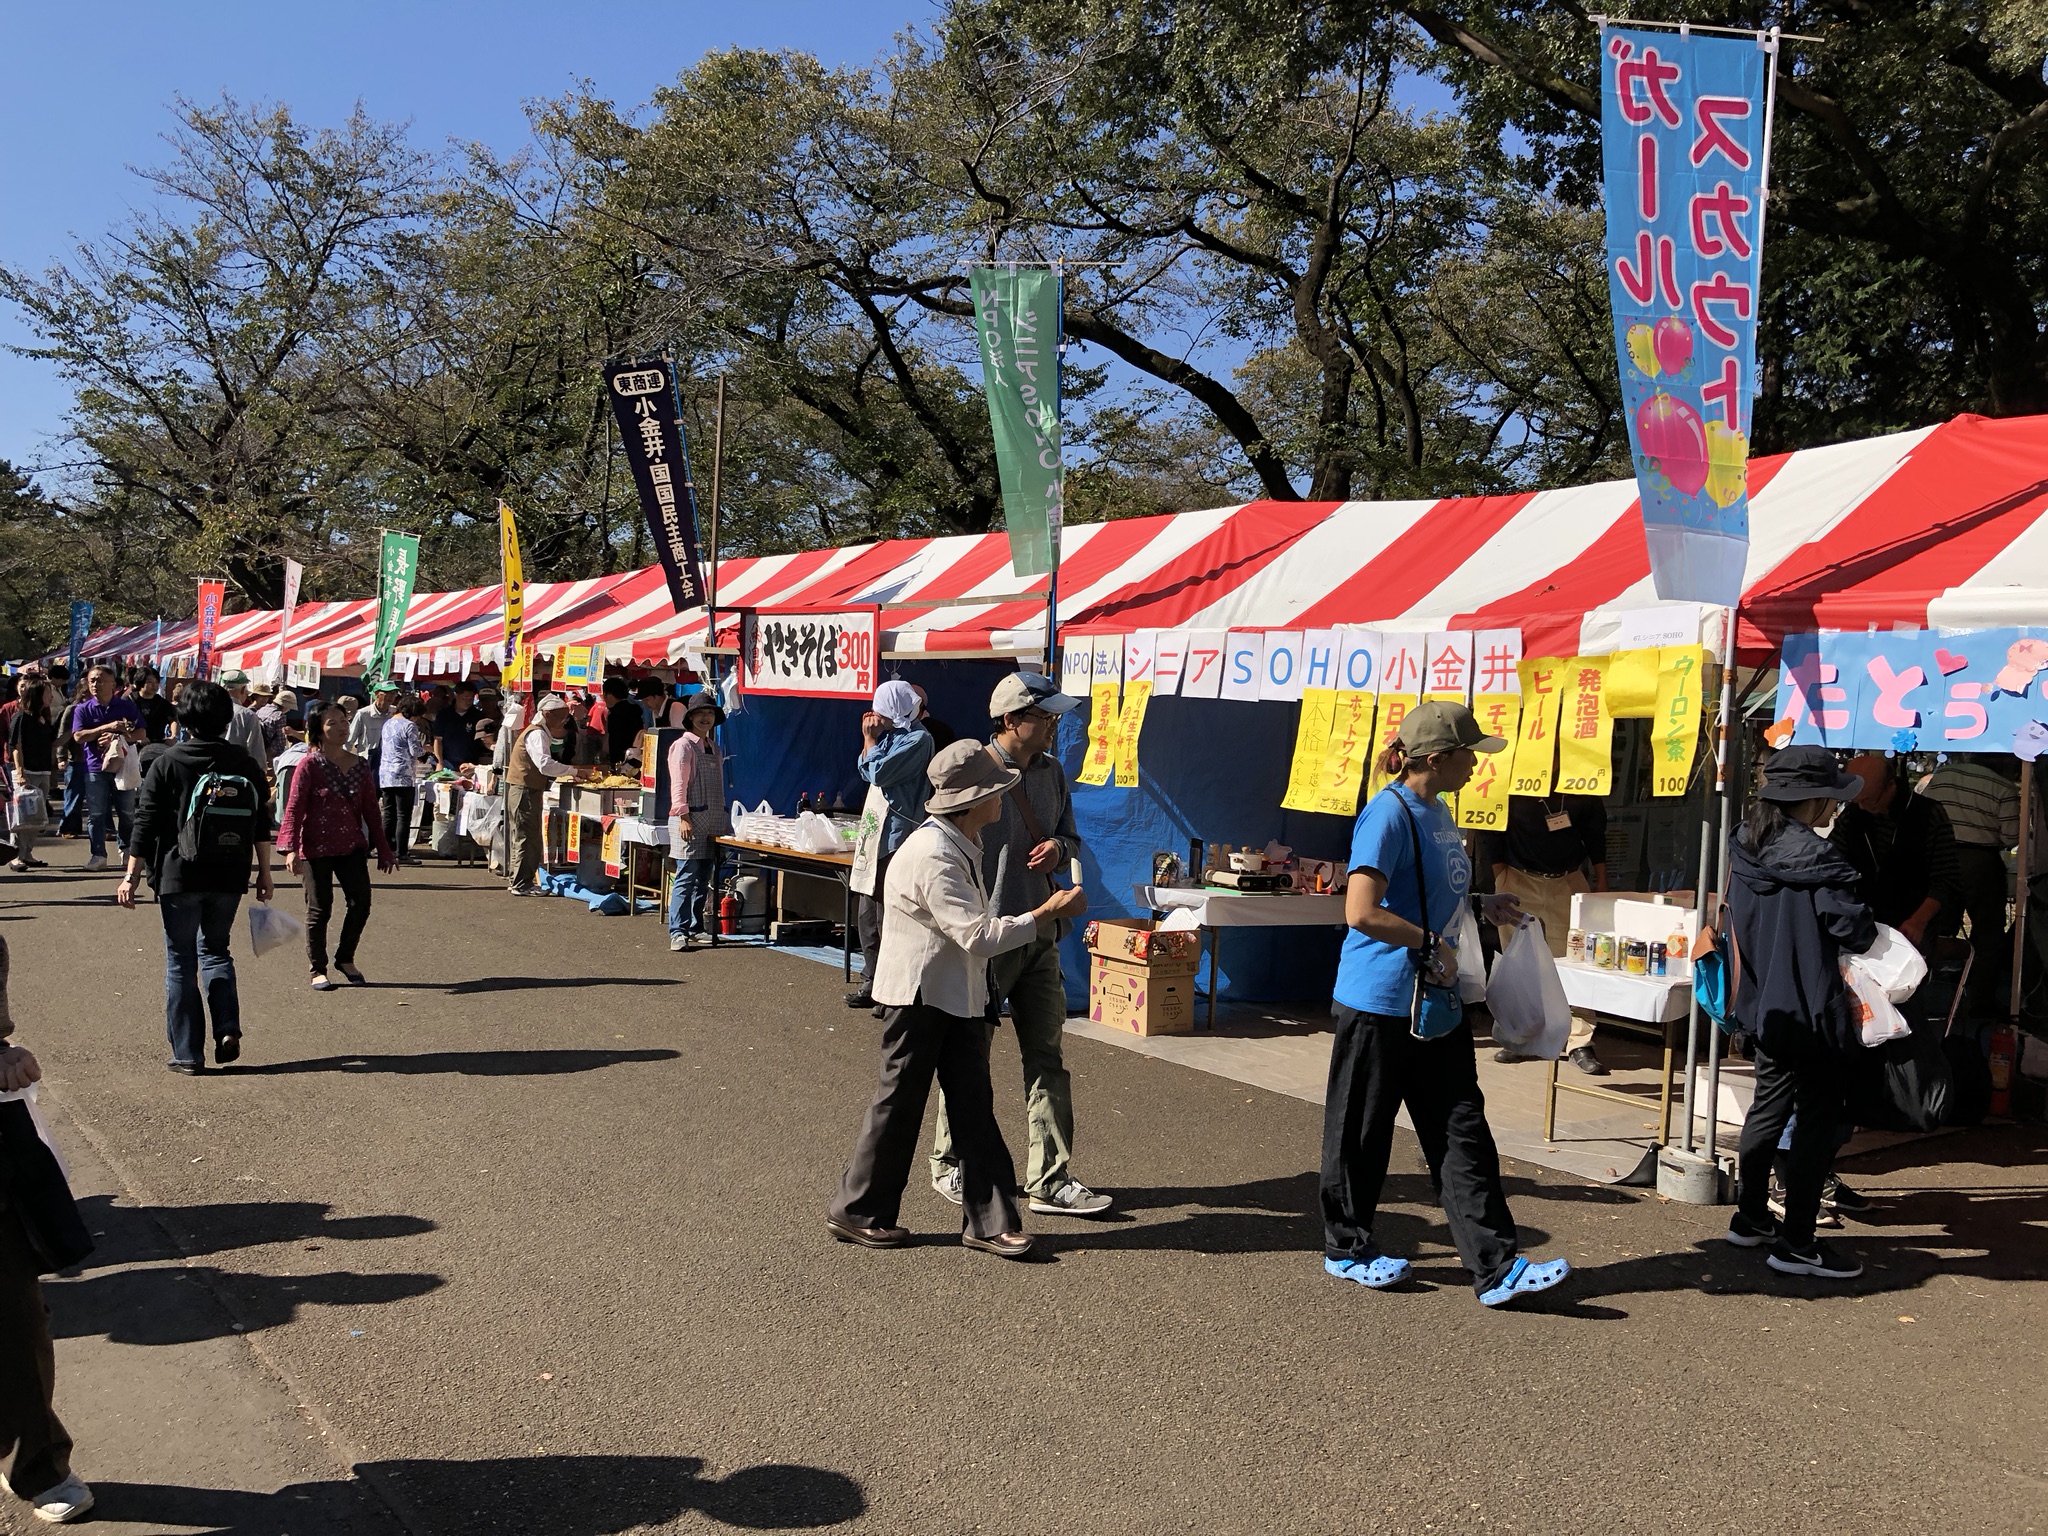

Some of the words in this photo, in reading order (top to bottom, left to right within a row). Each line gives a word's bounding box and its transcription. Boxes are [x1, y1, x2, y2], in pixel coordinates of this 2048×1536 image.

[616, 371, 662, 394] 東商連
[763, 621, 842, 679] やきそば
[1662, 631, 1684, 640] SOHO
[1302, 694, 1328, 752] 本格
[1528, 669, 1554, 741] ビール
[1573, 668, 1602, 740] 発泡酒
[1665, 655, 1695, 763] ウーロン茶
[1782, 652, 2048, 740] たとう
[1333, 695, 1363, 788] ホットワイン
[1475, 703, 1507, 799] チュハイ
